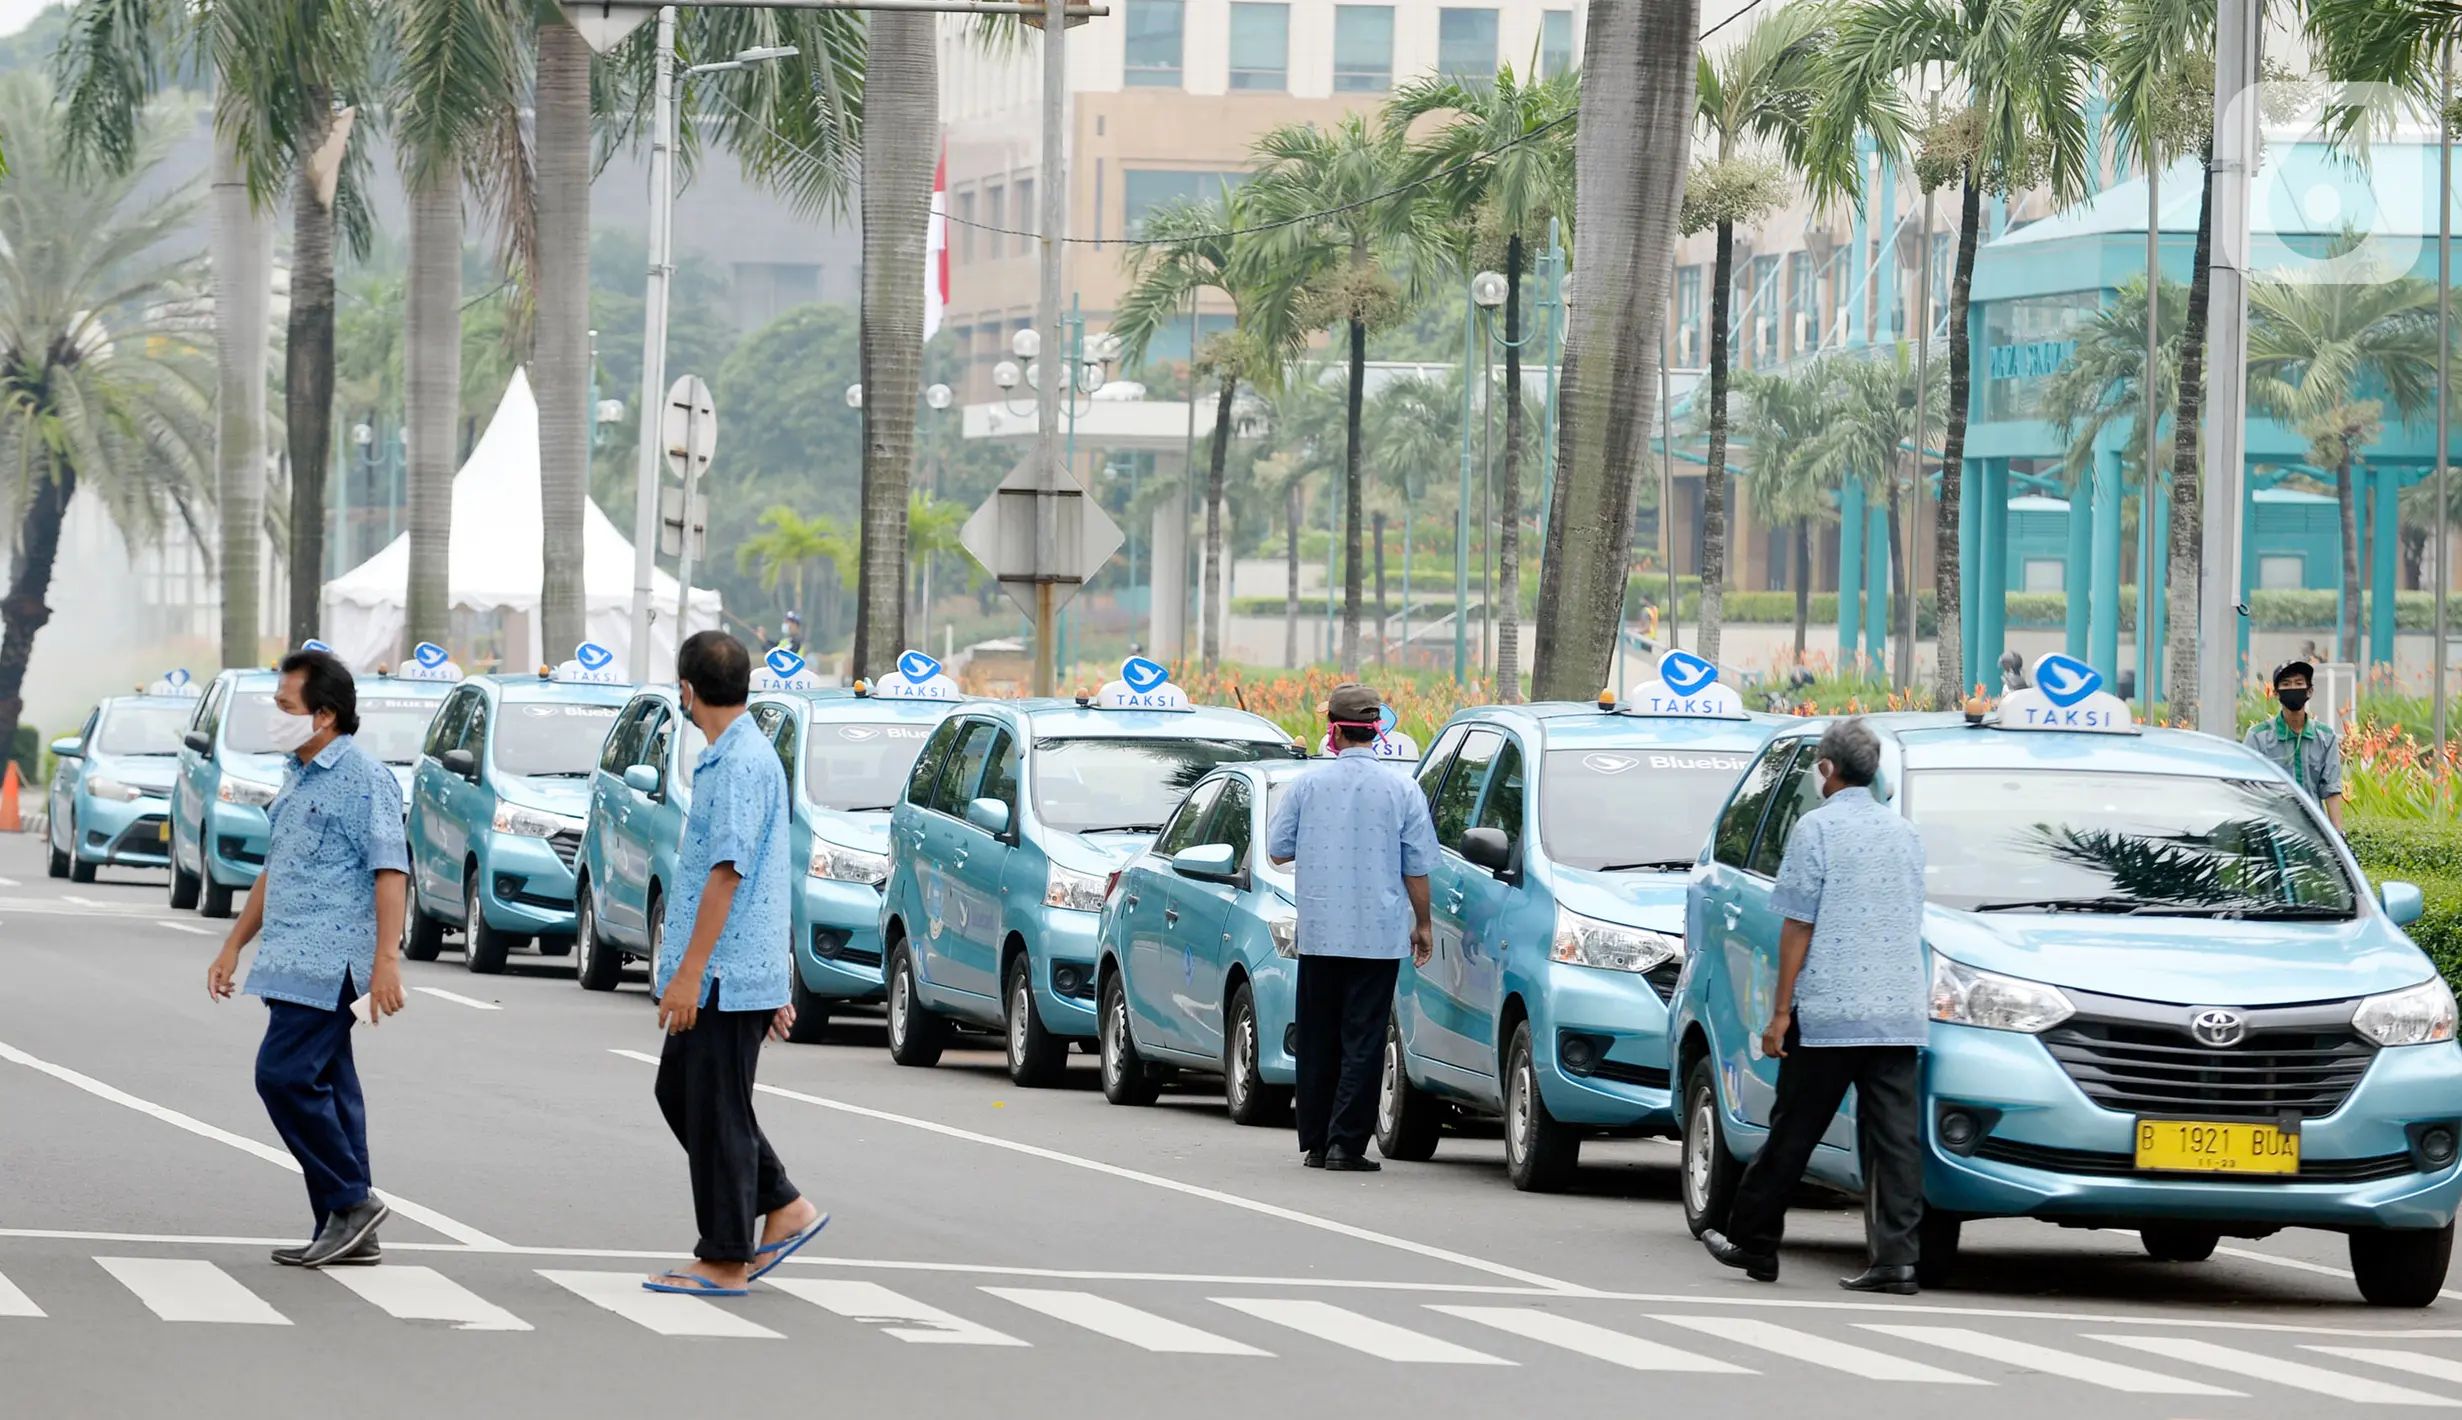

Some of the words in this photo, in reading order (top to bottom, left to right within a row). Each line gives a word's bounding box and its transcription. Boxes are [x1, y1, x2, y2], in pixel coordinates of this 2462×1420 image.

[411, 669, 453, 678] TAKSI
[572, 671, 617, 682] TAKSI
[761, 679, 811, 690] TAKSI
[893, 685, 946, 697] TAKSI
[1116, 694, 1174, 707] TAKSI
[1651, 698, 1723, 714] TAKSI
[564, 706, 620, 717] Bluebi
[2025, 708, 2110, 727] TAKSI
[887, 727, 931, 739] Blue
[1372, 743, 1402, 756] KSI
[1650, 755, 1749, 770] Bluebir
[2141, 1125, 2155, 1151] B
[2180, 1127, 2229, 1154] 1921
[2252, 1129, 2294, 1157] BUA
